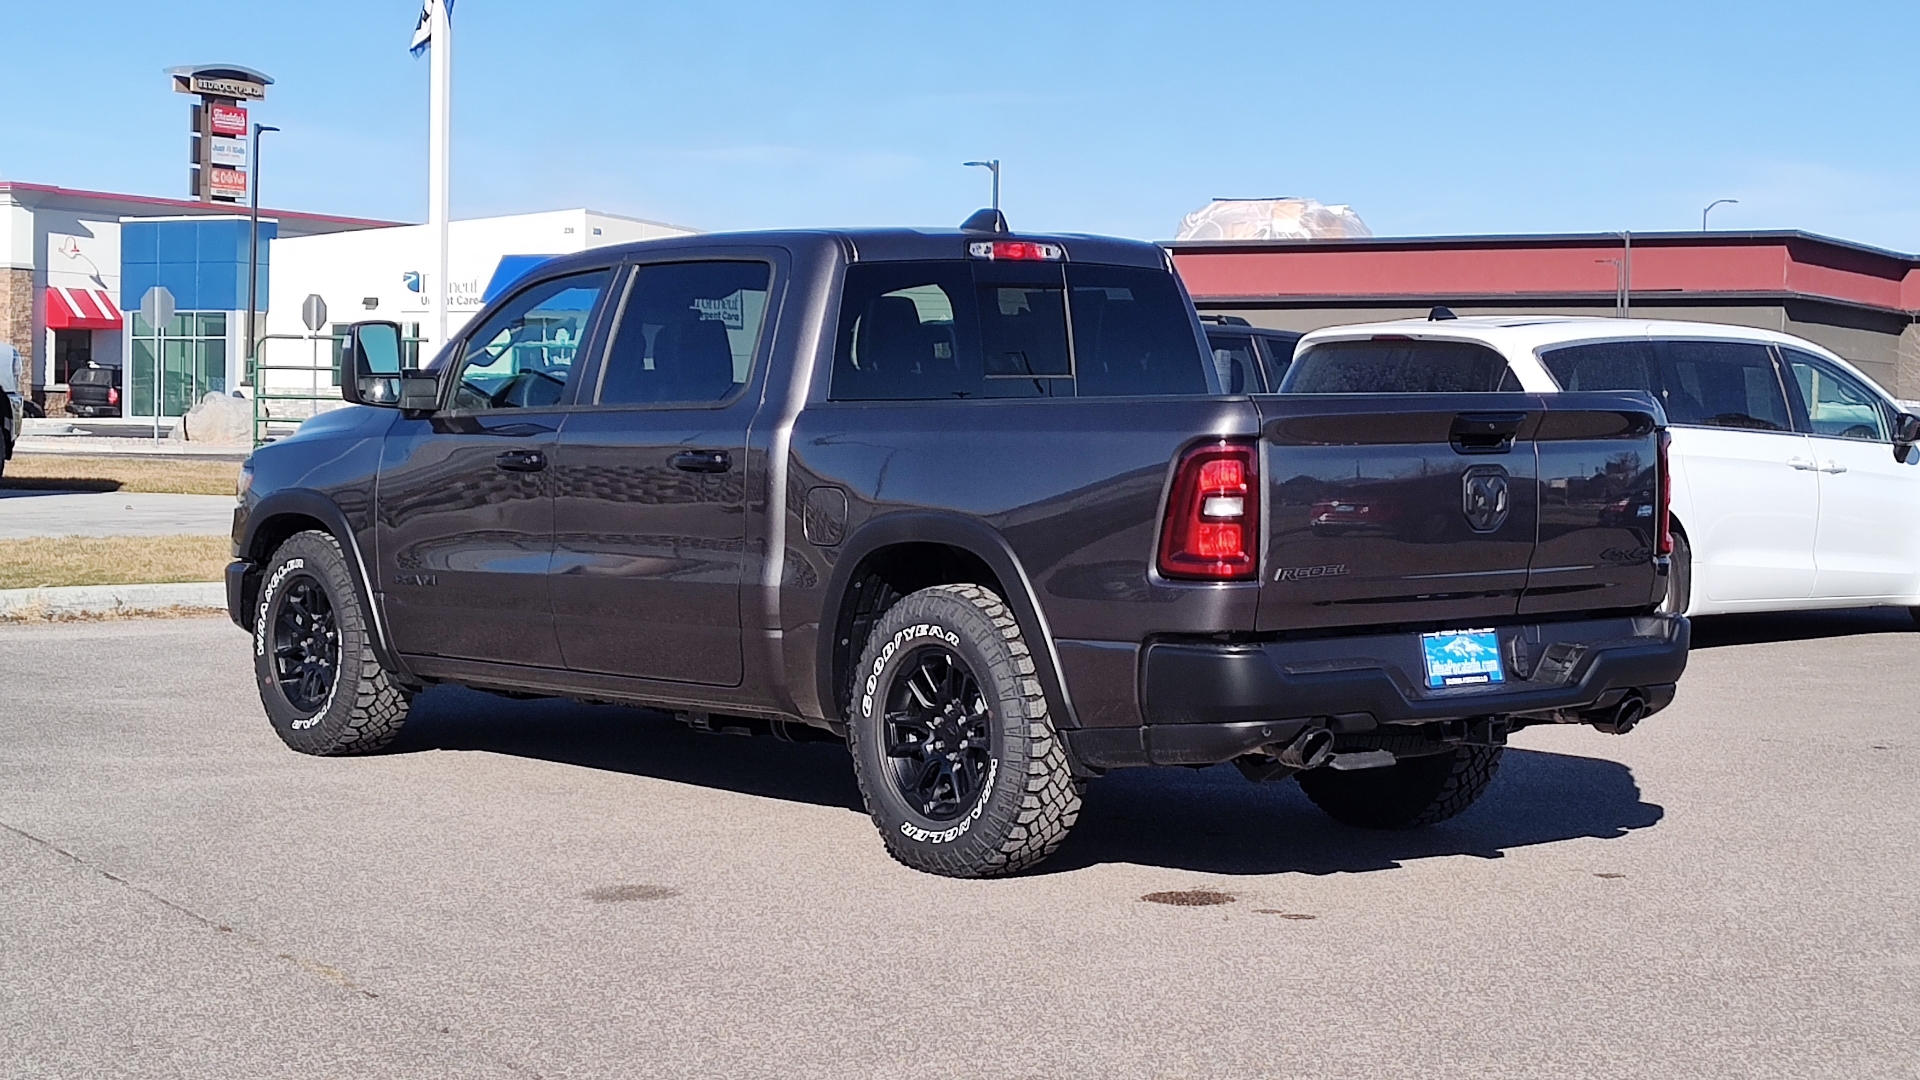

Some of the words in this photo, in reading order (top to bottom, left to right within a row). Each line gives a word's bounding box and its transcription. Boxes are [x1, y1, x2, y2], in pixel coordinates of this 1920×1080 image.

[456, 295, 480, 305] Care
[257, 558, 305, 656] WRANGLER
[862, 624, 960, 718] GOODYEAR
[900, 758, 998, 844] WRANGLER
